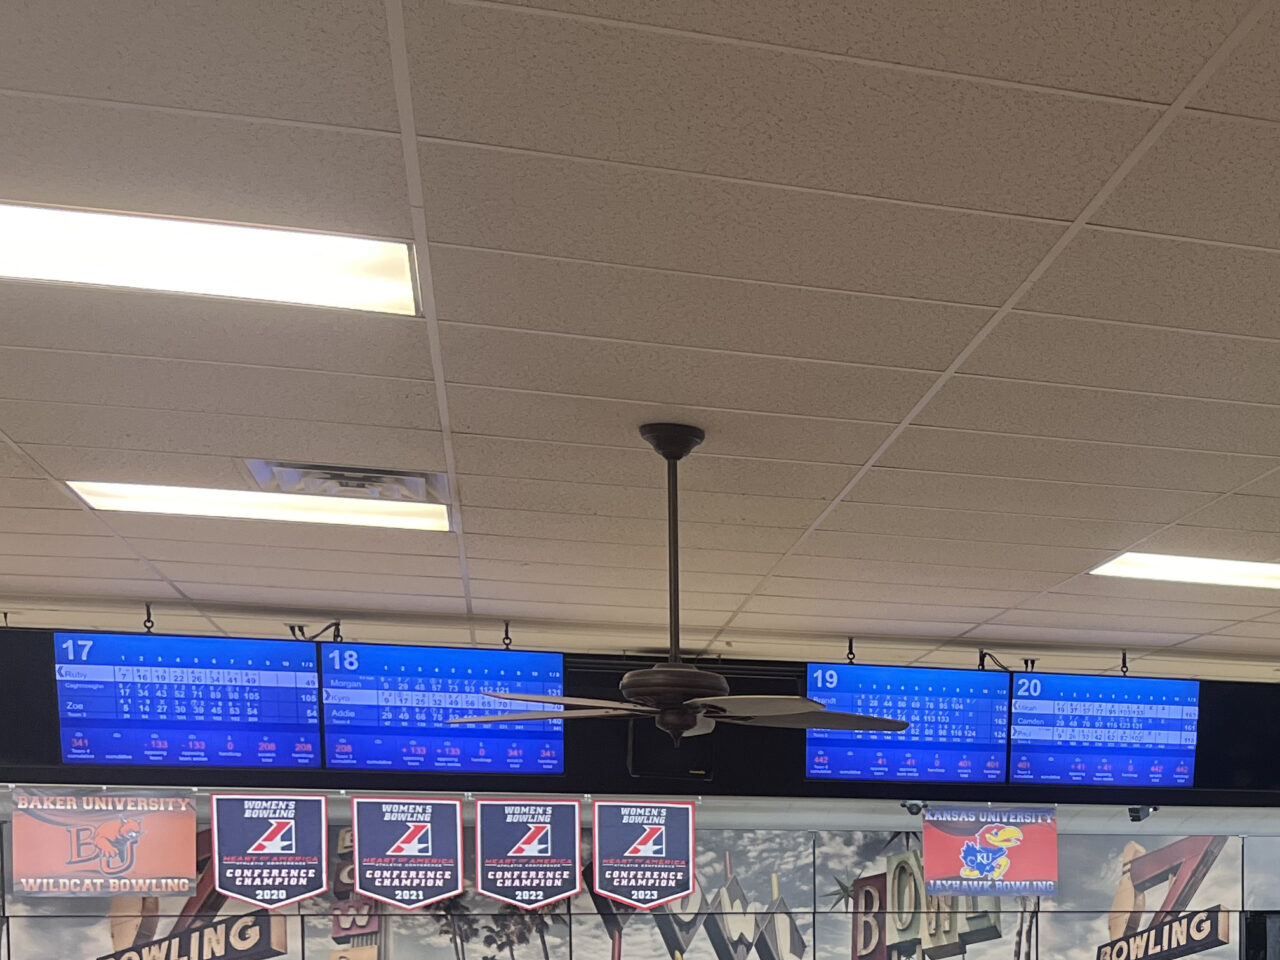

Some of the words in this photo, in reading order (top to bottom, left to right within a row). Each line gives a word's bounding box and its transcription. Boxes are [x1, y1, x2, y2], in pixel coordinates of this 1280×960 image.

[62, 639, 93, 660] 17
[329, 650, 358, 670] 18
[64, 670, 88, 679] Ruby
[813, 669, 838, 688] 19
[330, 679, 362, 689] Morgan
[1017, 678, 1041, 696] 20
[137, 689, 149, 697] 34
[244, 692, 260, 700] 105
[301, 694, 317, 702] 105
[331, 709, 355, 717] Addie
[1017, 717, 1045, 725] Camden
[17, 796, 77, 810] BAKER
[83, 796, 190, 811] UNIVERSITY
[244, 801, 296, 810] WOMEN'S
[382, 804, 432, 813] WOMEN'S
[504, 806, 552, 814] WOMEN'S
[621, 807, 666, 816] WOMEN'S
[243, 809, 295, 818] BOWLING
[383, 813, 431, 821] BOWLING
[506, 814, 551, 822] BOWLING
[925, 810, 976, 822] KANSAS
[979, 811, 1053, 823] UNIVERSITY
[622, 816, 665, 824] BOWLING
[977, 853, 993, 864] KU
[226, 869, 316, 877] CONFERENCE
[365, 870, 451, 879] CONFERENCE
[487, 871, 570, 879] CONFERENCE
[605, 871, 683, 880] CONFERENCE
[20, 878, 104, 892] WILDCAT
[109, 878, 190, 892] BOWLING
[235, 877, 307, 886] CHAMPION
[375, 879, 444, 887] CHAMPION
[496, 879, 562, 887] CHAMPION
[613, 879, 676, 887] CHAMPION
[928, 880, 992, 891] JAYHAWK
[995, 880, 1055, 892] BOWLING
[255, 890, 287, 900] 2020
[395, 890, 424, 900] 2021
[515, 890, 543, 900] 2022
[631, 890, 658, 900] 2023
